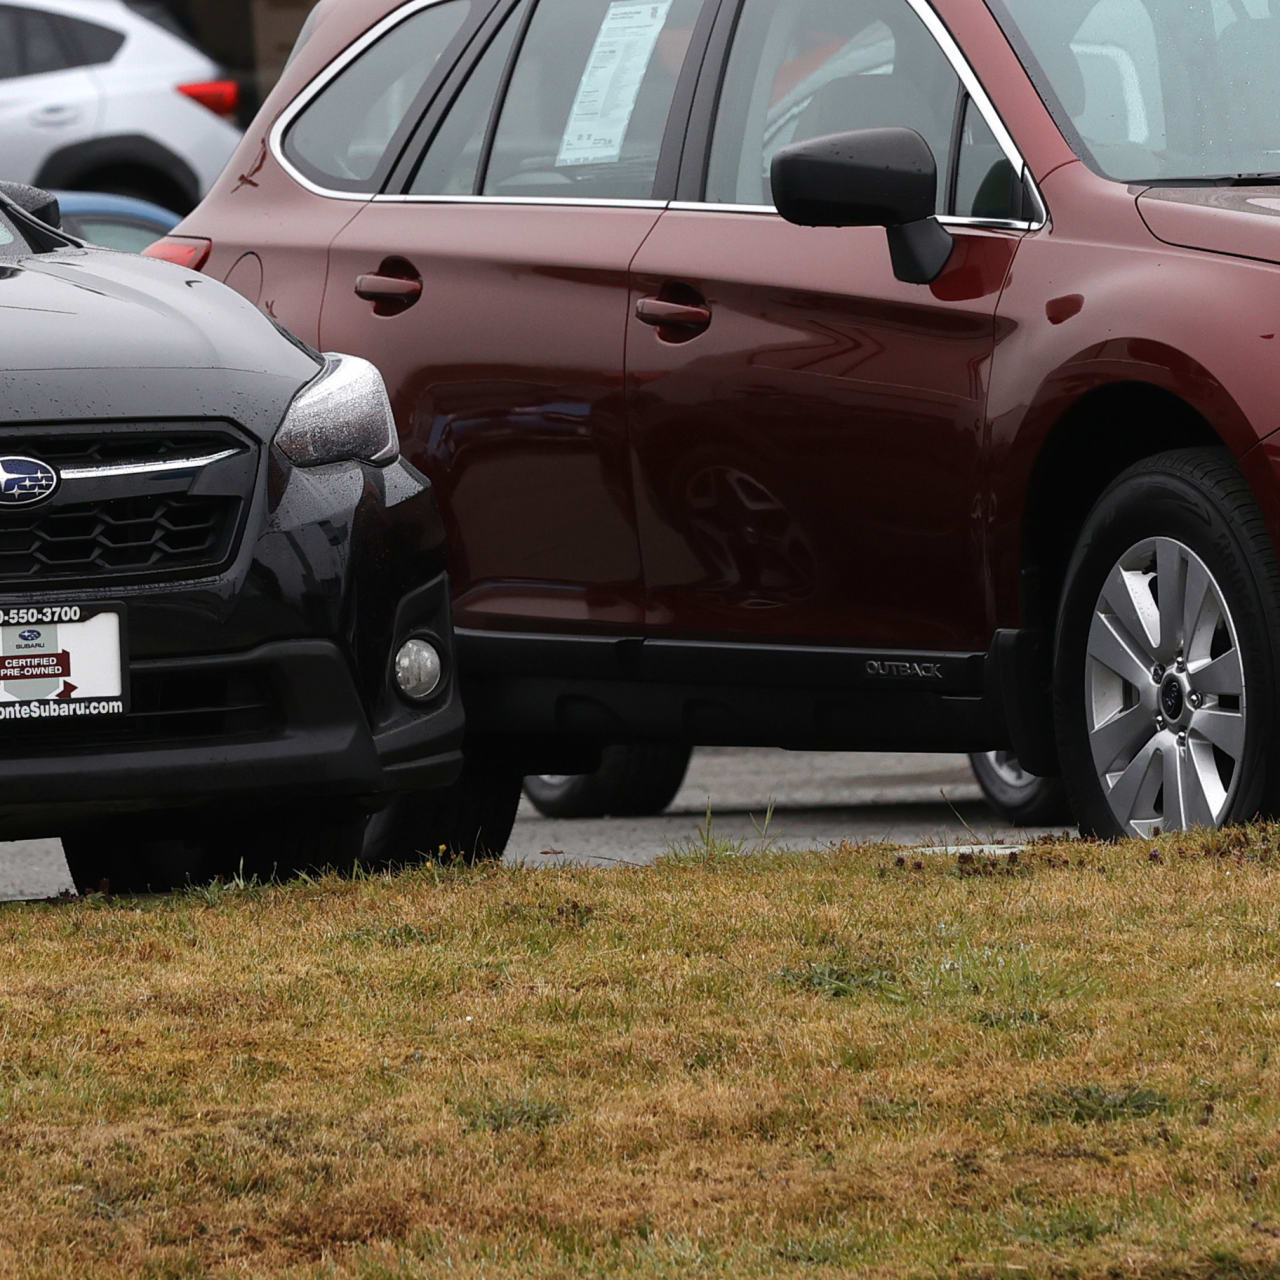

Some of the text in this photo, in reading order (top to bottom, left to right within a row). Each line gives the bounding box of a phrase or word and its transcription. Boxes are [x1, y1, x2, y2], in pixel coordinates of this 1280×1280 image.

[4, 657, 57, 668] CERTIFIED
[0, 665, 63, 677] PRE-OWNED
[866, 661, 942, 678] OUTBACK
